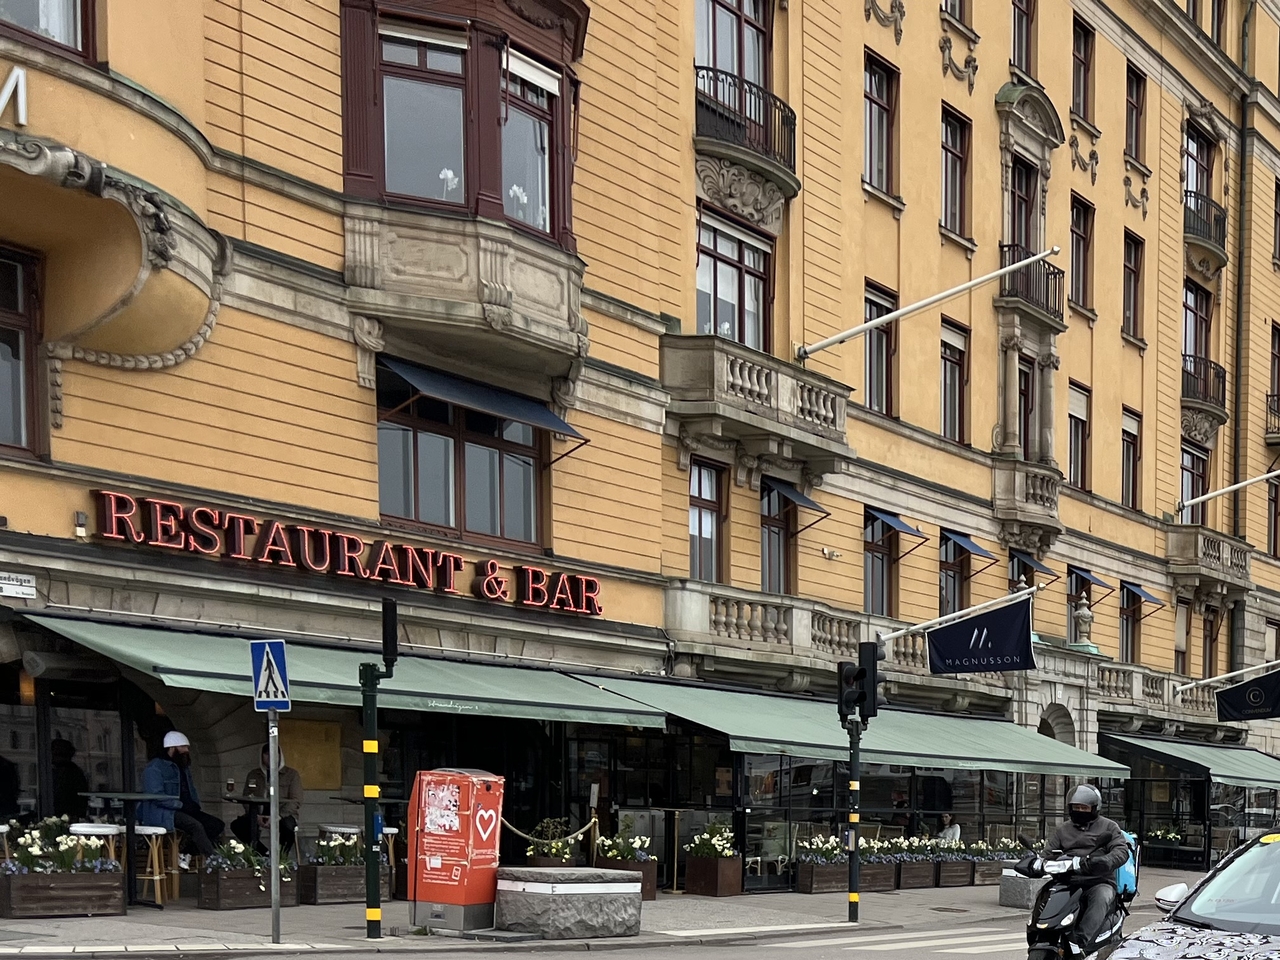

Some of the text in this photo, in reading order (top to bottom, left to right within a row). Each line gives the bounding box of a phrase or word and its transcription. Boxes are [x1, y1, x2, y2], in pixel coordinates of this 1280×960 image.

[96, 489, 603, 615] RESTAURANT & BAR
[945, 656, 1020, 666] MAGNUSSON
